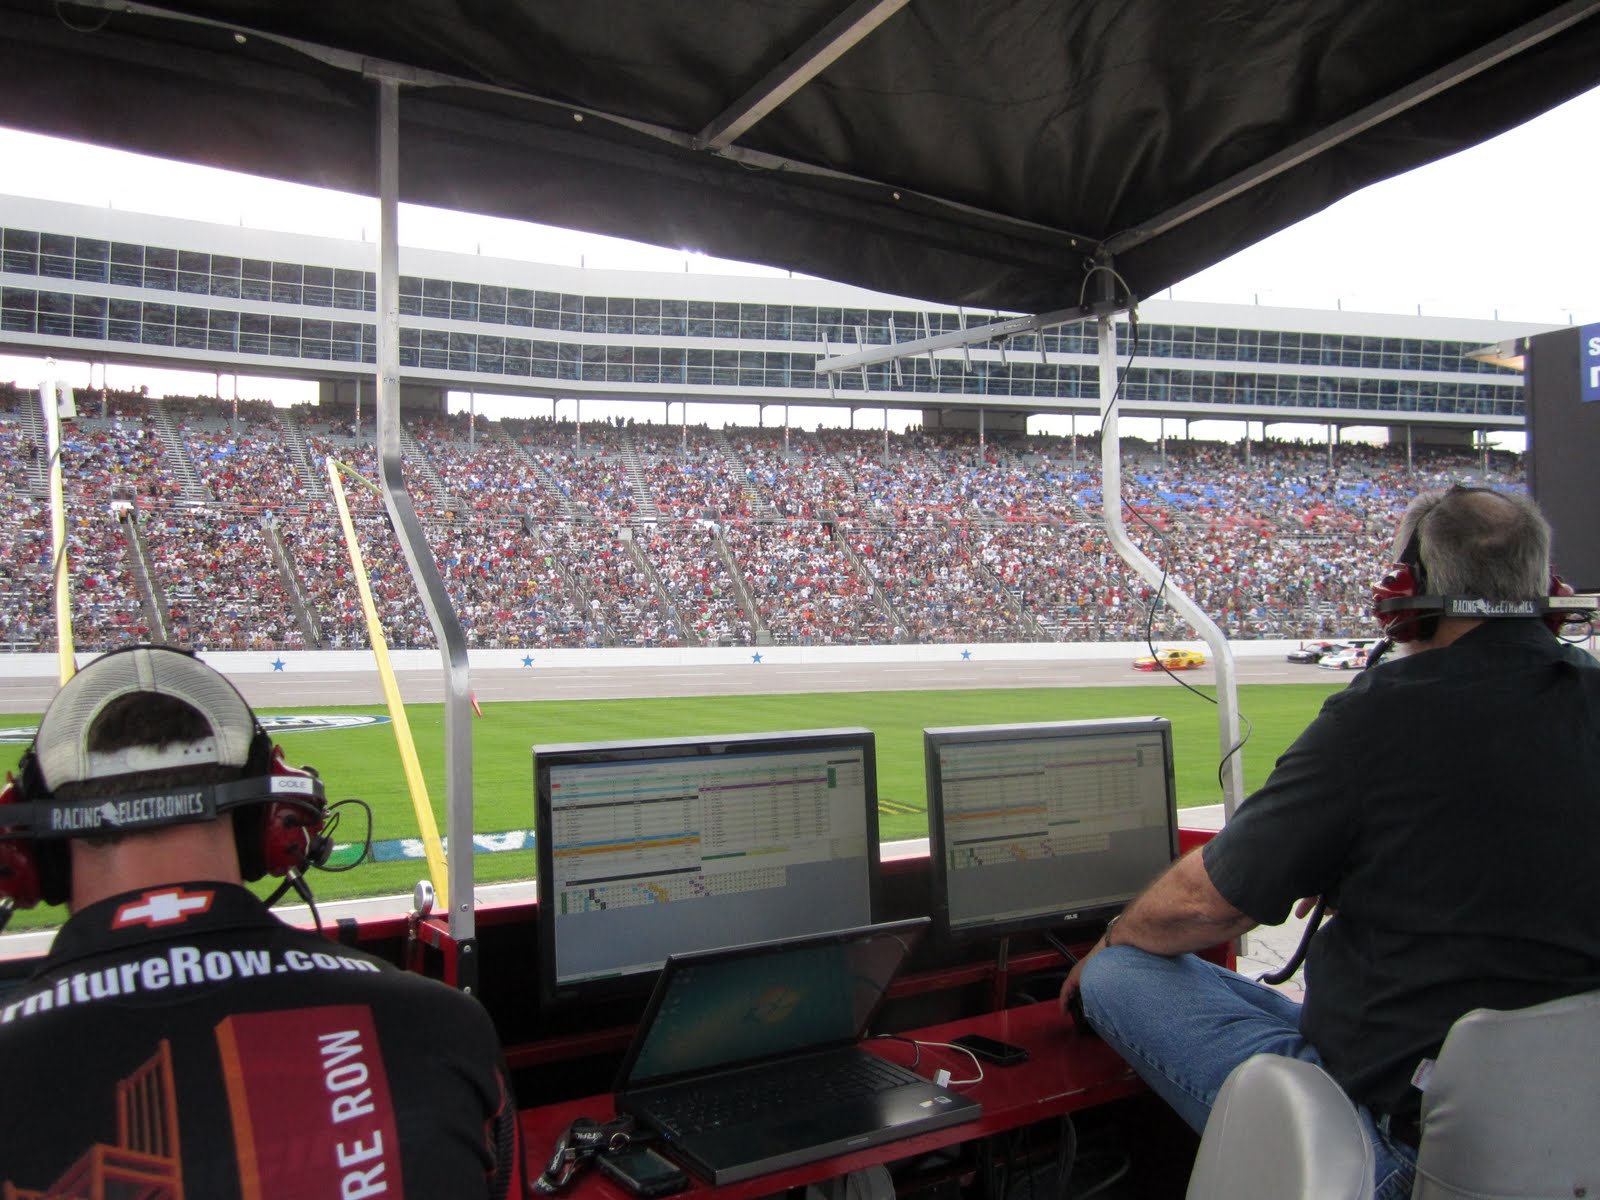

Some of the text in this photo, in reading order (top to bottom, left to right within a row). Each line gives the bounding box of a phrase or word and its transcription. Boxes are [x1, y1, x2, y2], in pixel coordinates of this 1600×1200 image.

[1452, 600, 1477, 613] RACING
[278, 779, 307, 789] COLE
[53, 793, 204, 830] RACING ELECTRONICS
[318, 1029, 375, 1124] ROW
